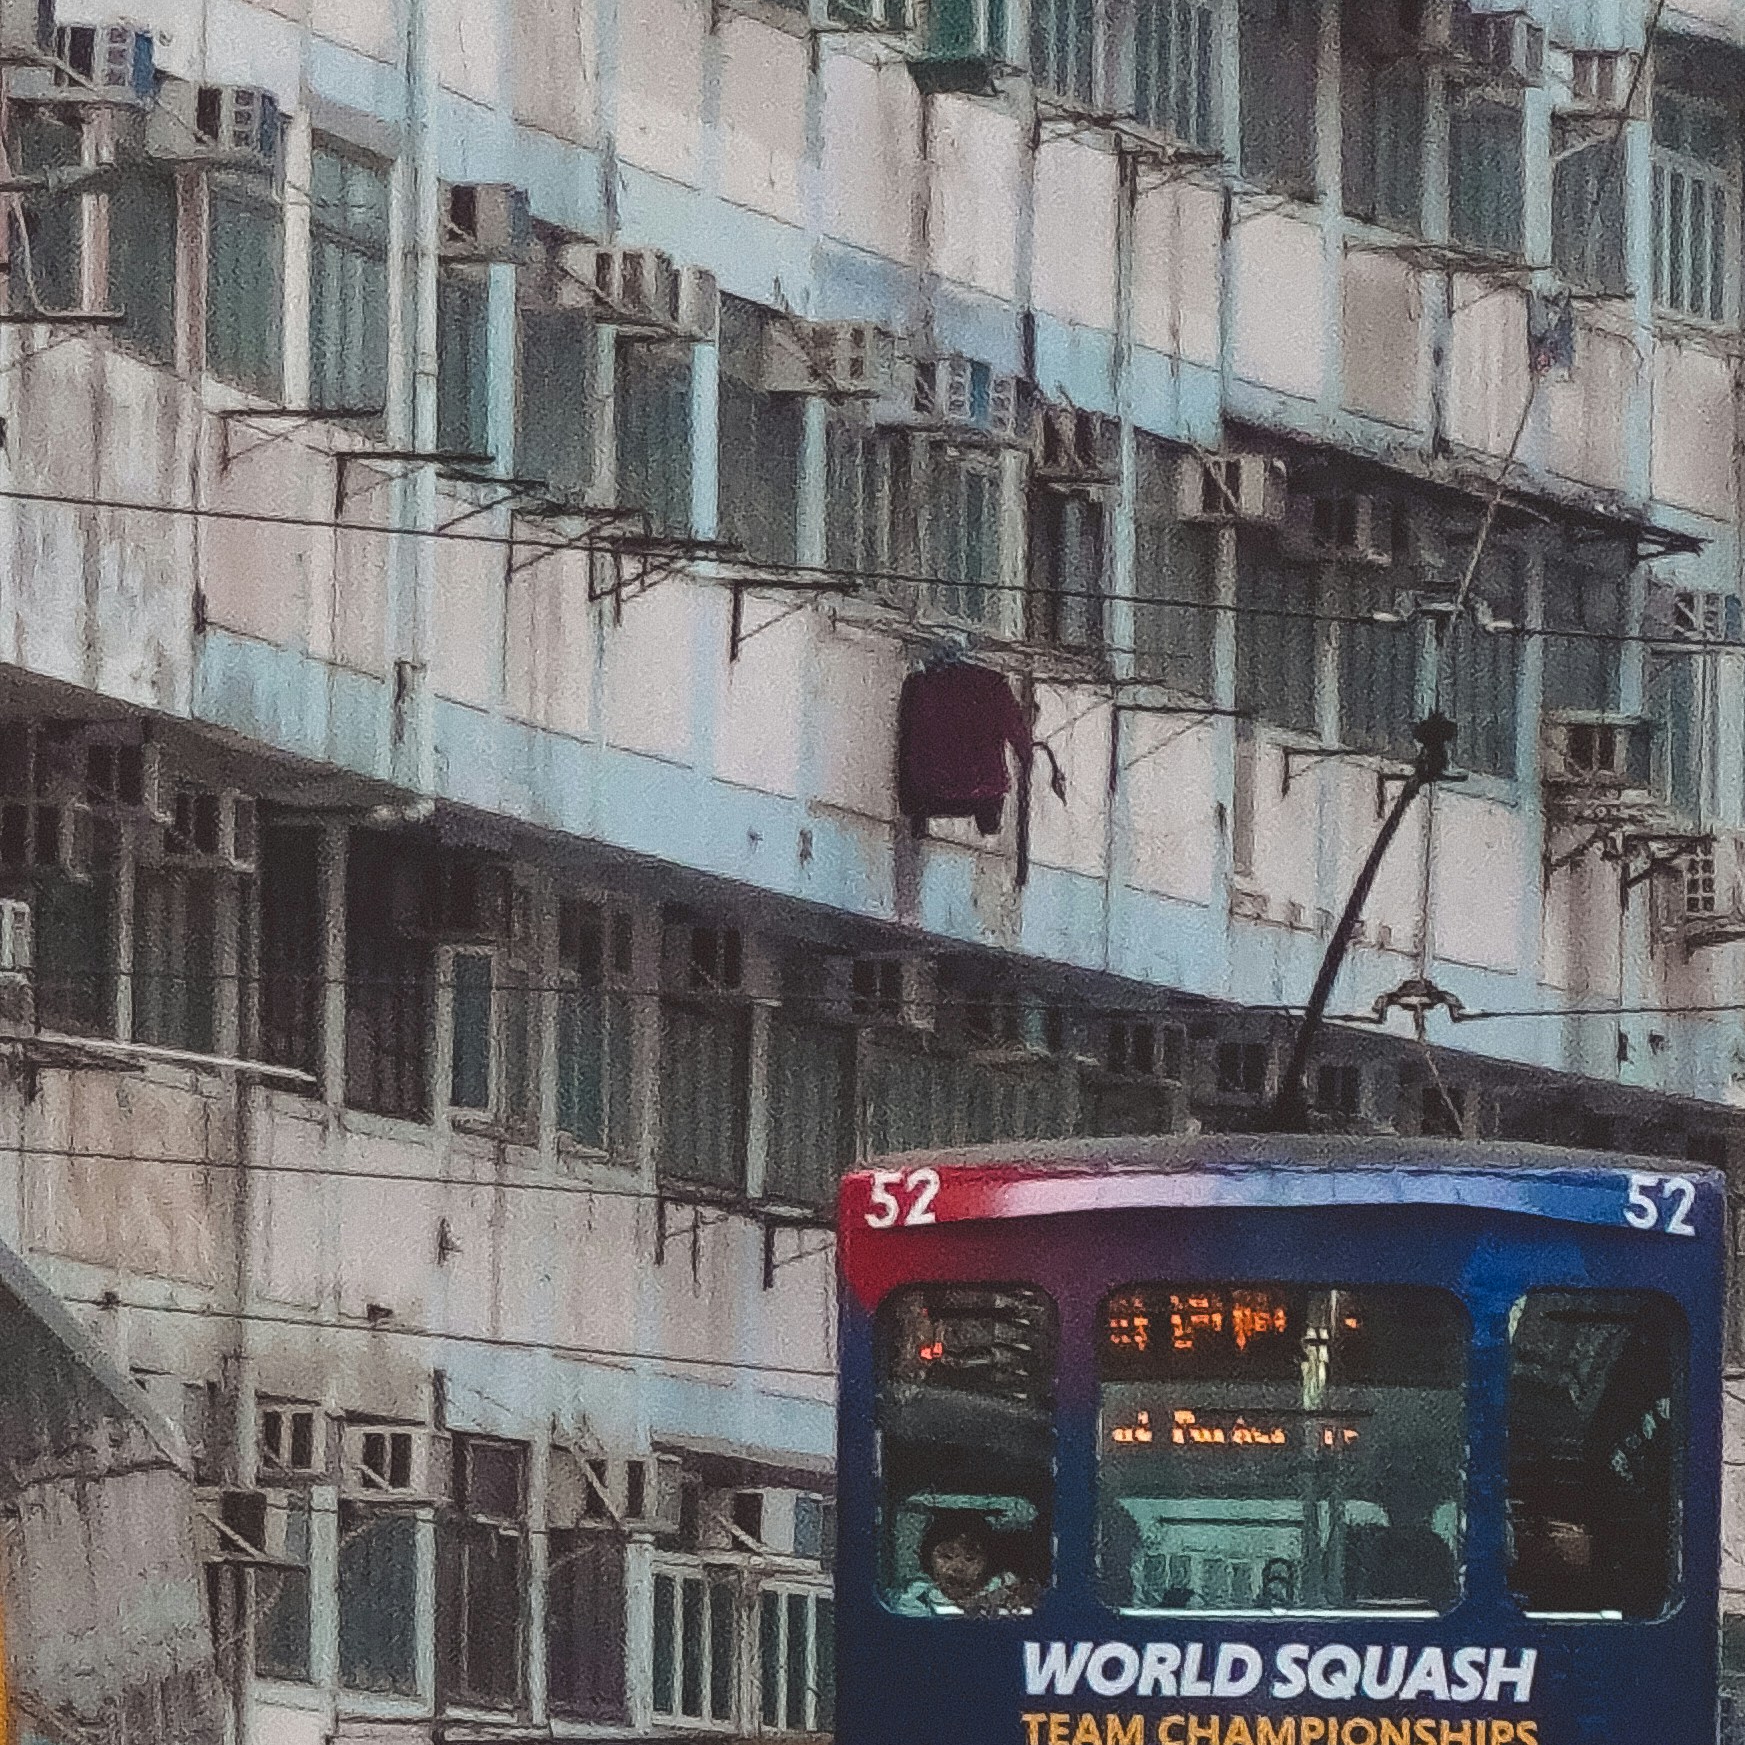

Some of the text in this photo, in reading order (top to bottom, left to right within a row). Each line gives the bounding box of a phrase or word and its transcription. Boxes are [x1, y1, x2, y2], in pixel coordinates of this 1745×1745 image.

[864, 1167, 941, 1227] 52
[1624, 1175, 1696, 1236] 52
[1023, 1641, 1537, 1702] WORLD SQUASH
